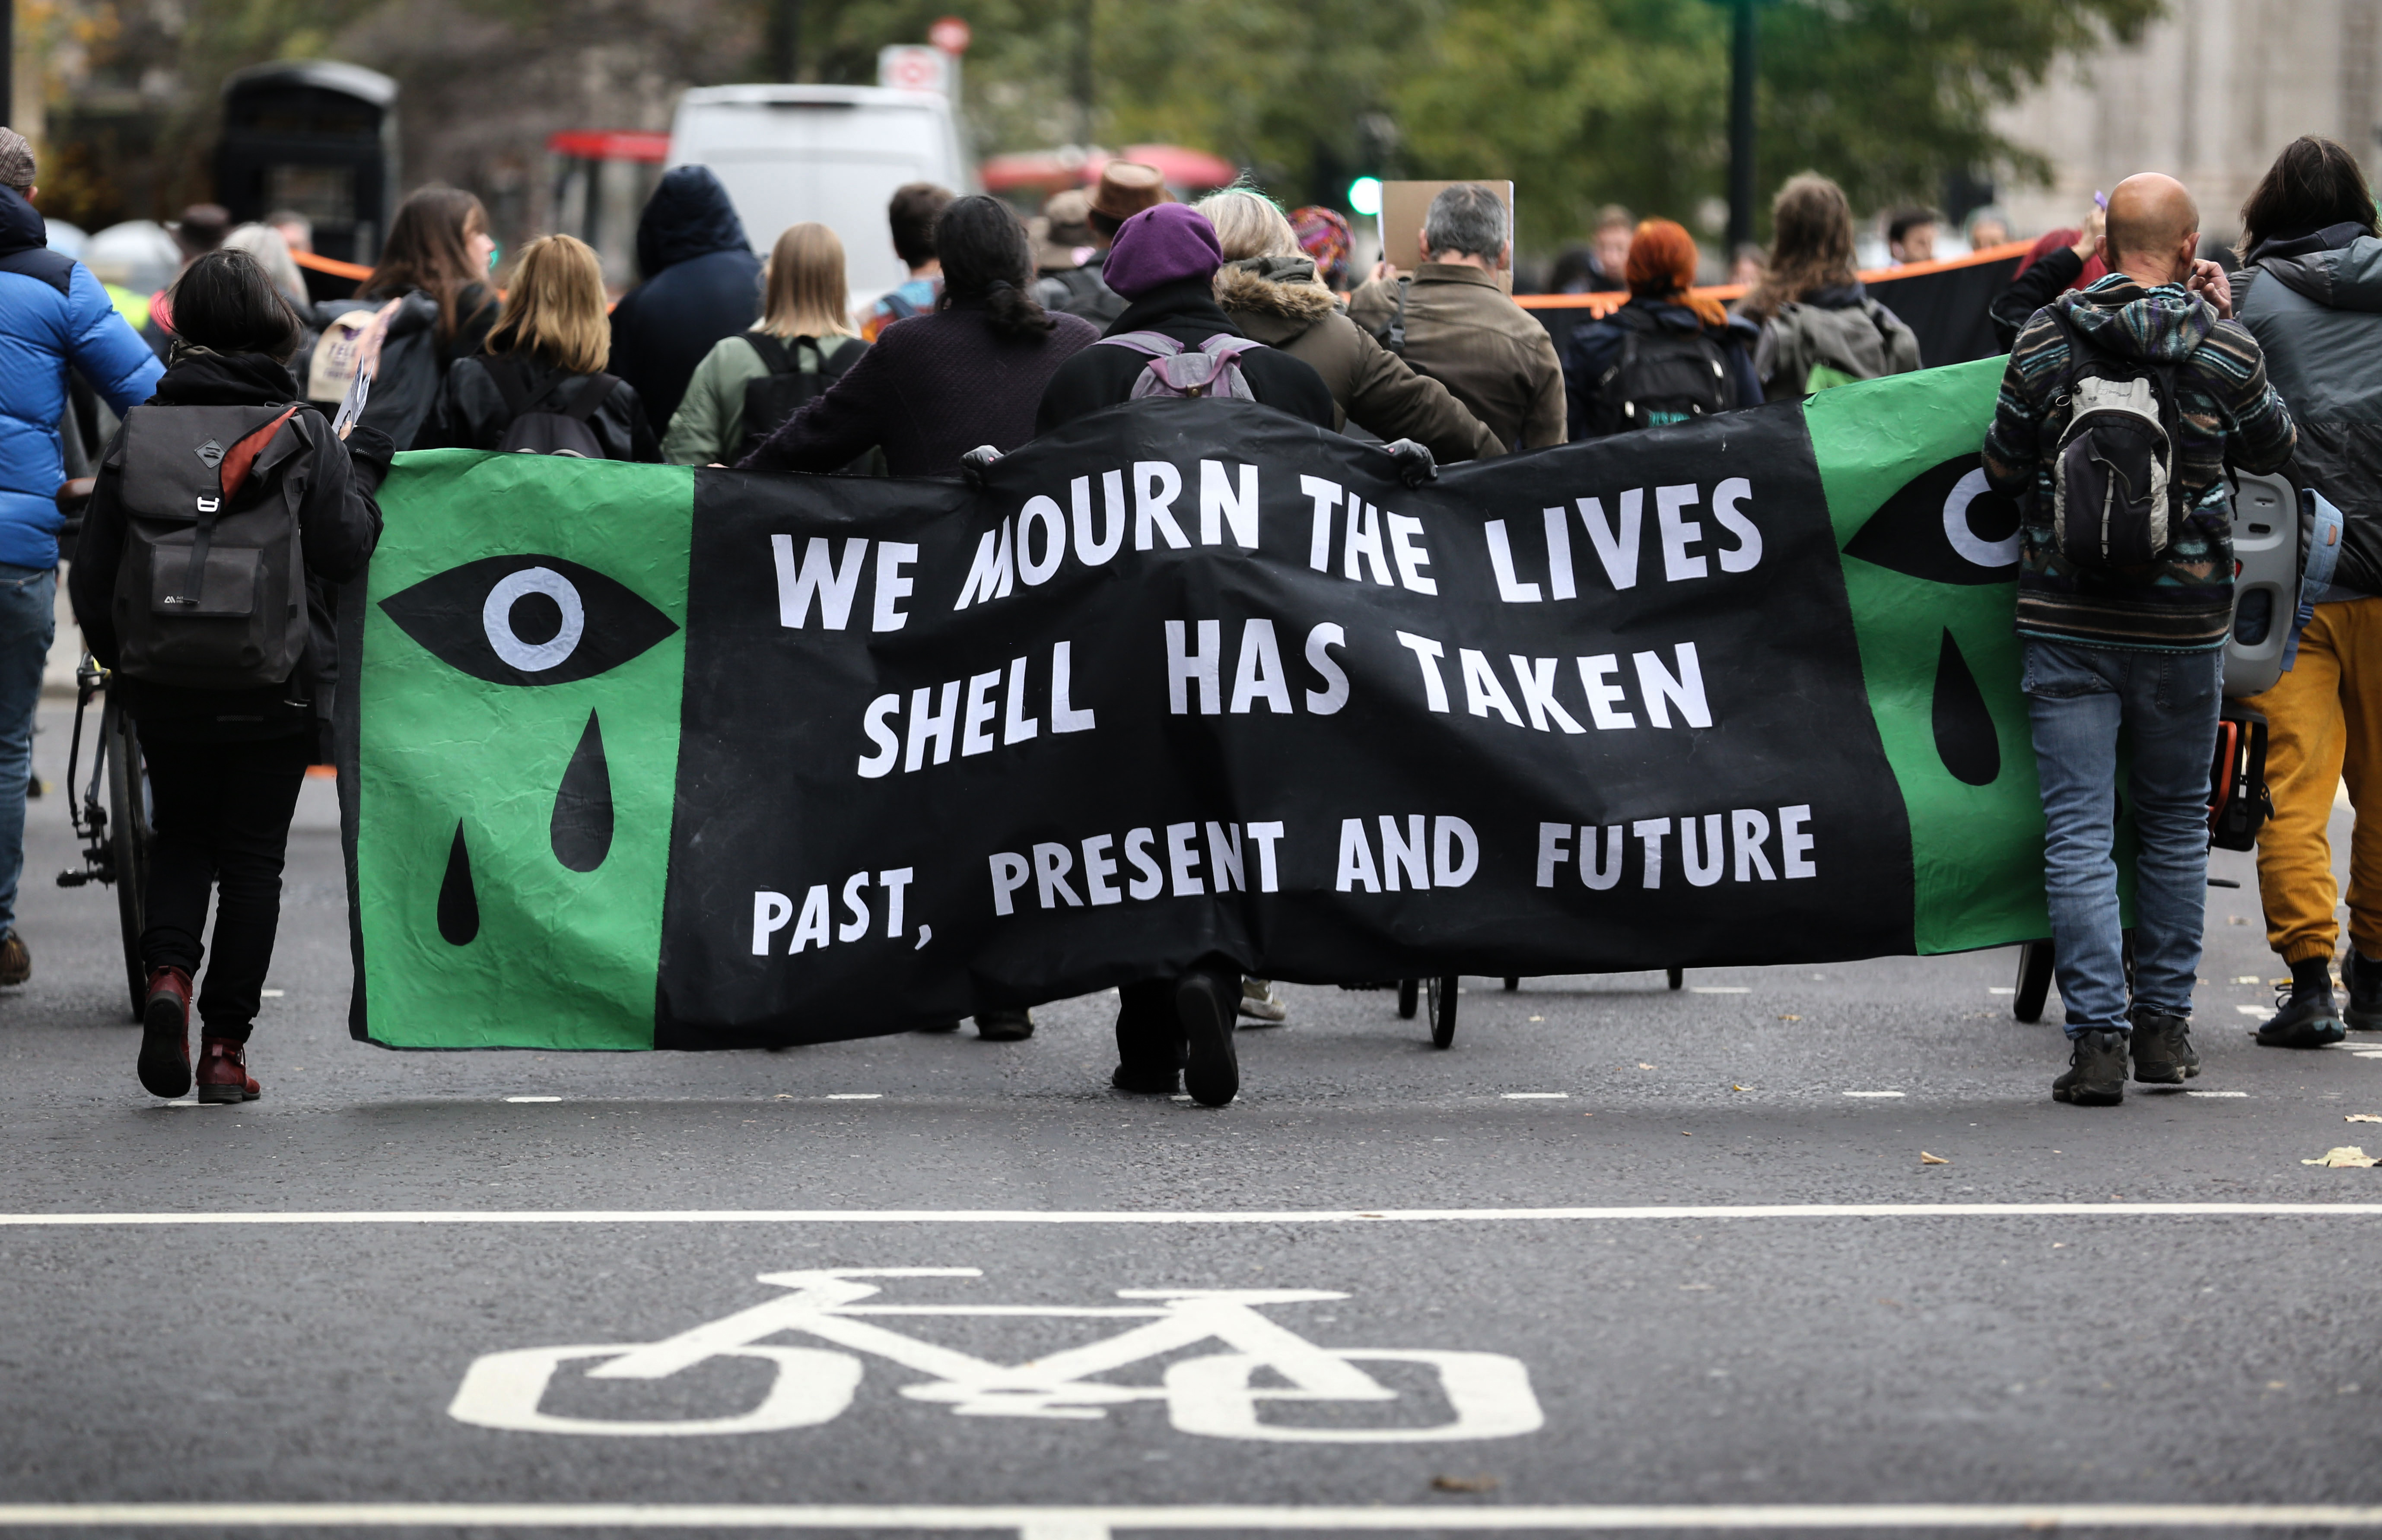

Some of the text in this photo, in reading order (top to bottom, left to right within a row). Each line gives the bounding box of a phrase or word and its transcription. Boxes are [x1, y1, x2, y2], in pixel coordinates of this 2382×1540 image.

[770, 459, 1762, 632] WE MOURN THE LIVES
[857, 618, 1713, 778] SHELL HAS TAKEN
[752, 804, 1816, 956] PAST, PRESENT AND FUTURE
